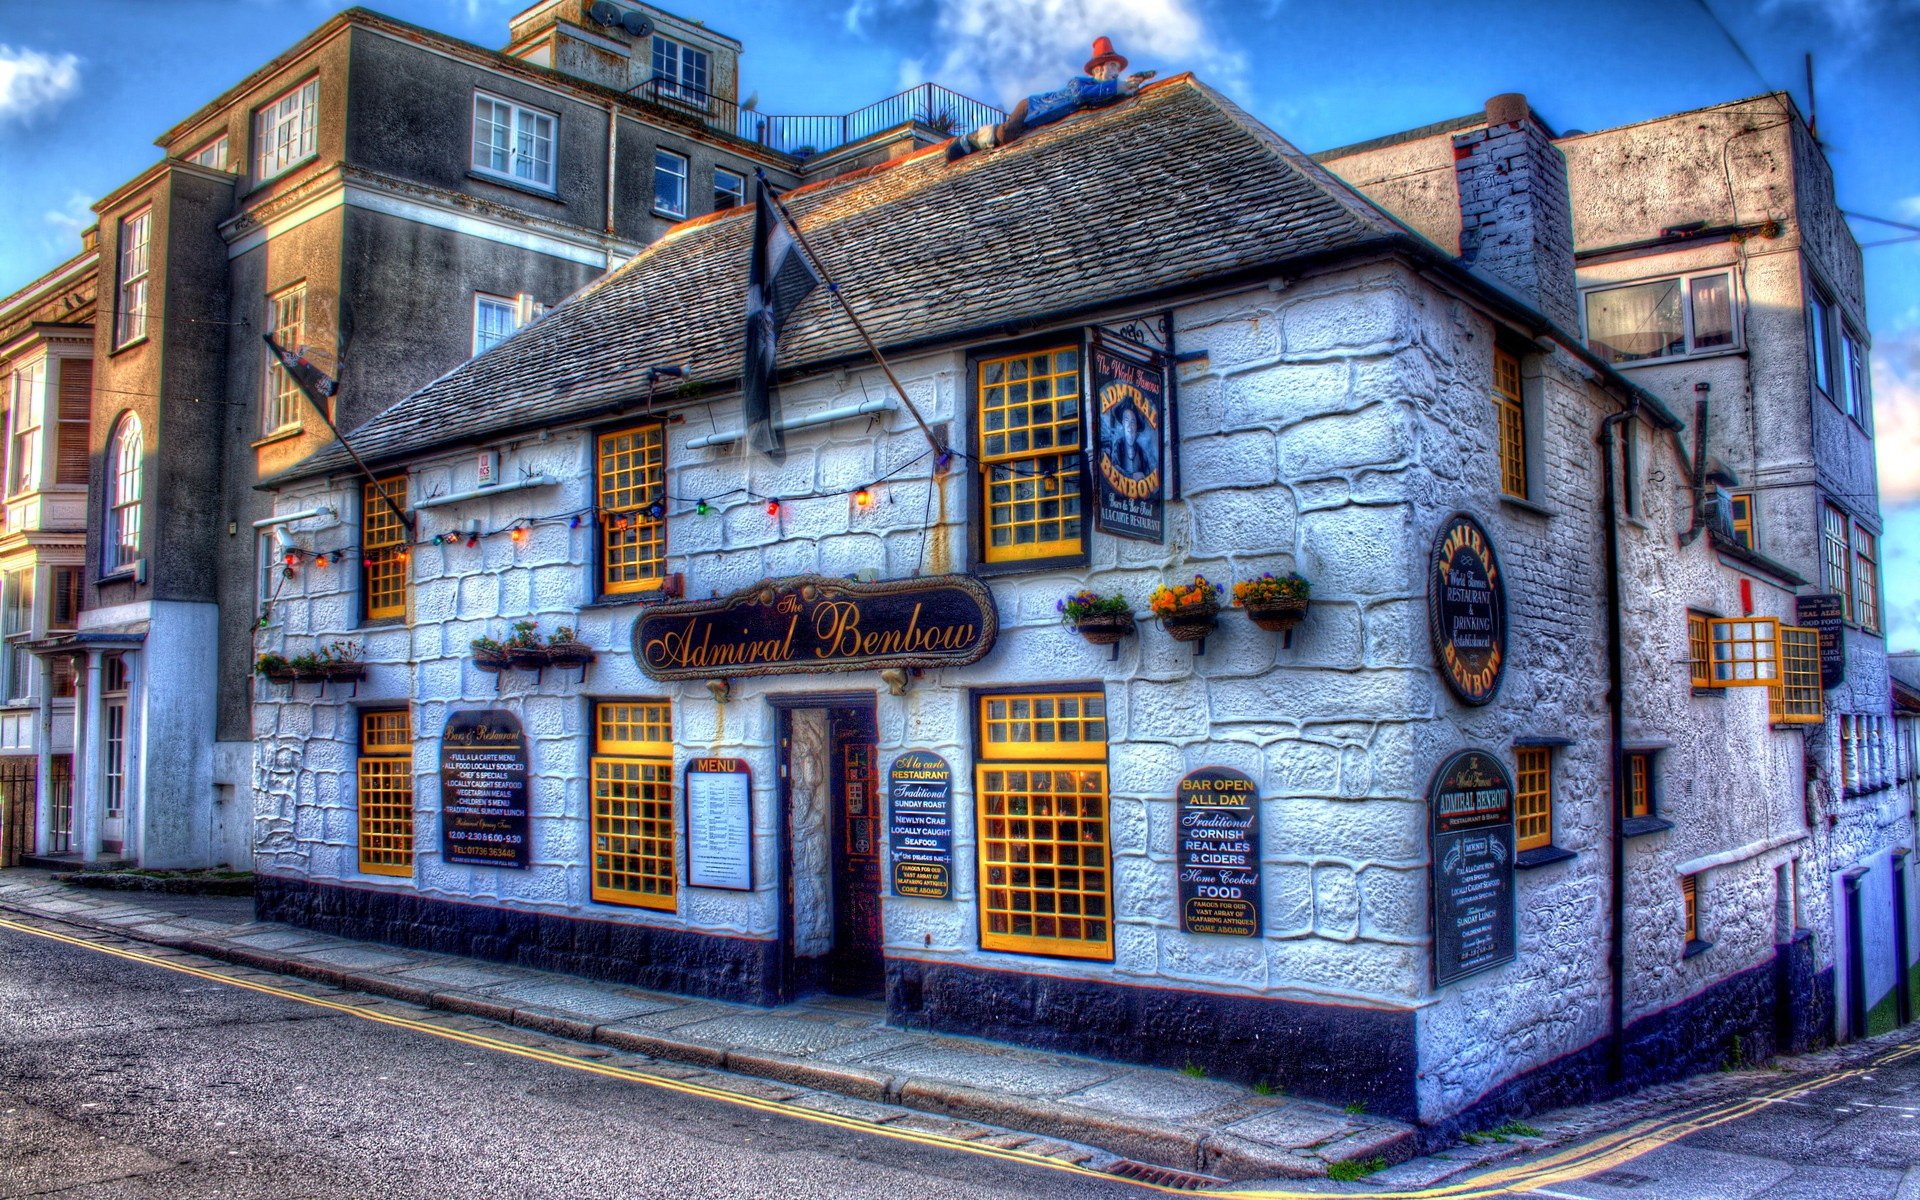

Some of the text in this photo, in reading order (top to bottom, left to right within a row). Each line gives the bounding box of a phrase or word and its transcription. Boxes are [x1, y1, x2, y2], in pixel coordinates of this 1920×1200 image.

[1100, 384, 1158, 430] ADMIRAL
[1101, 452, 1159, 499] BENBOW
[1112, 510, 1130, 525] CARTE
[1130, 514, 1160, 531] RESTAURANT
[1439, 524, 1498, 591] ADMIRAL
[1449, 568, 1466, 587] World
[1447, 587, 1491, 604] RESTAURANT
[777, 595, 803, 614] The
[1468, 604, 1474, 615] &
[1453, 615, 1490, 631] DRINKING
[646, 601, 976, 669] Admiral Benbow
[1453, 629, 1490, 647] Establishment
[1444, 638, 1502, 696] BENBOW
[476, 725, 520, 740] Restaurant
[698, 759, 737, 773] MENU
[896, 755, 945, 769] A la carte
[891, 771, 949, 779] RESTAURANT
[471, 780, 494, 788] CAUGHT
[494, 781, 523, 789] SEAFOOD
[893, 784, 948, 798] Traditional
[1182, 780, 1254, 791] BAR OPEN
[895, 800, 947, 809] SUNDAY ROAST
[1190, 795, 1247, 806] ALL DAY
[1440, 789, 1508, 814] ADMIRAL BENBOW
[481, 807, 504, 815] SUNDAY
[895, 815, 946, 825] NEWLYN CRAB
[1182, 811, 1255, 828] Traditional
[1449, 815, 1481, 825] RESTAURANT
[891, 827, 951, 836] LOCALLY CAUGHT
[1191, 829, 1244, 840] CORNISH
[904, 837, 937, 846] SEAFOOD
[1185, 841, 1250, 852] REAL ALES
[1465, 842, 1485, 852] MENU
[1191, 854, 1246, 865] & CIDERS
[1180, 869, 1259, 885] Home Cooked
[919, 887, 942, 895] ABOARD
[1197, 886, 1242, 899] FOOD
[1478, 909, 1497, 921] LUNCH
[1194, 924, 1249, 935] COME ABOARD
